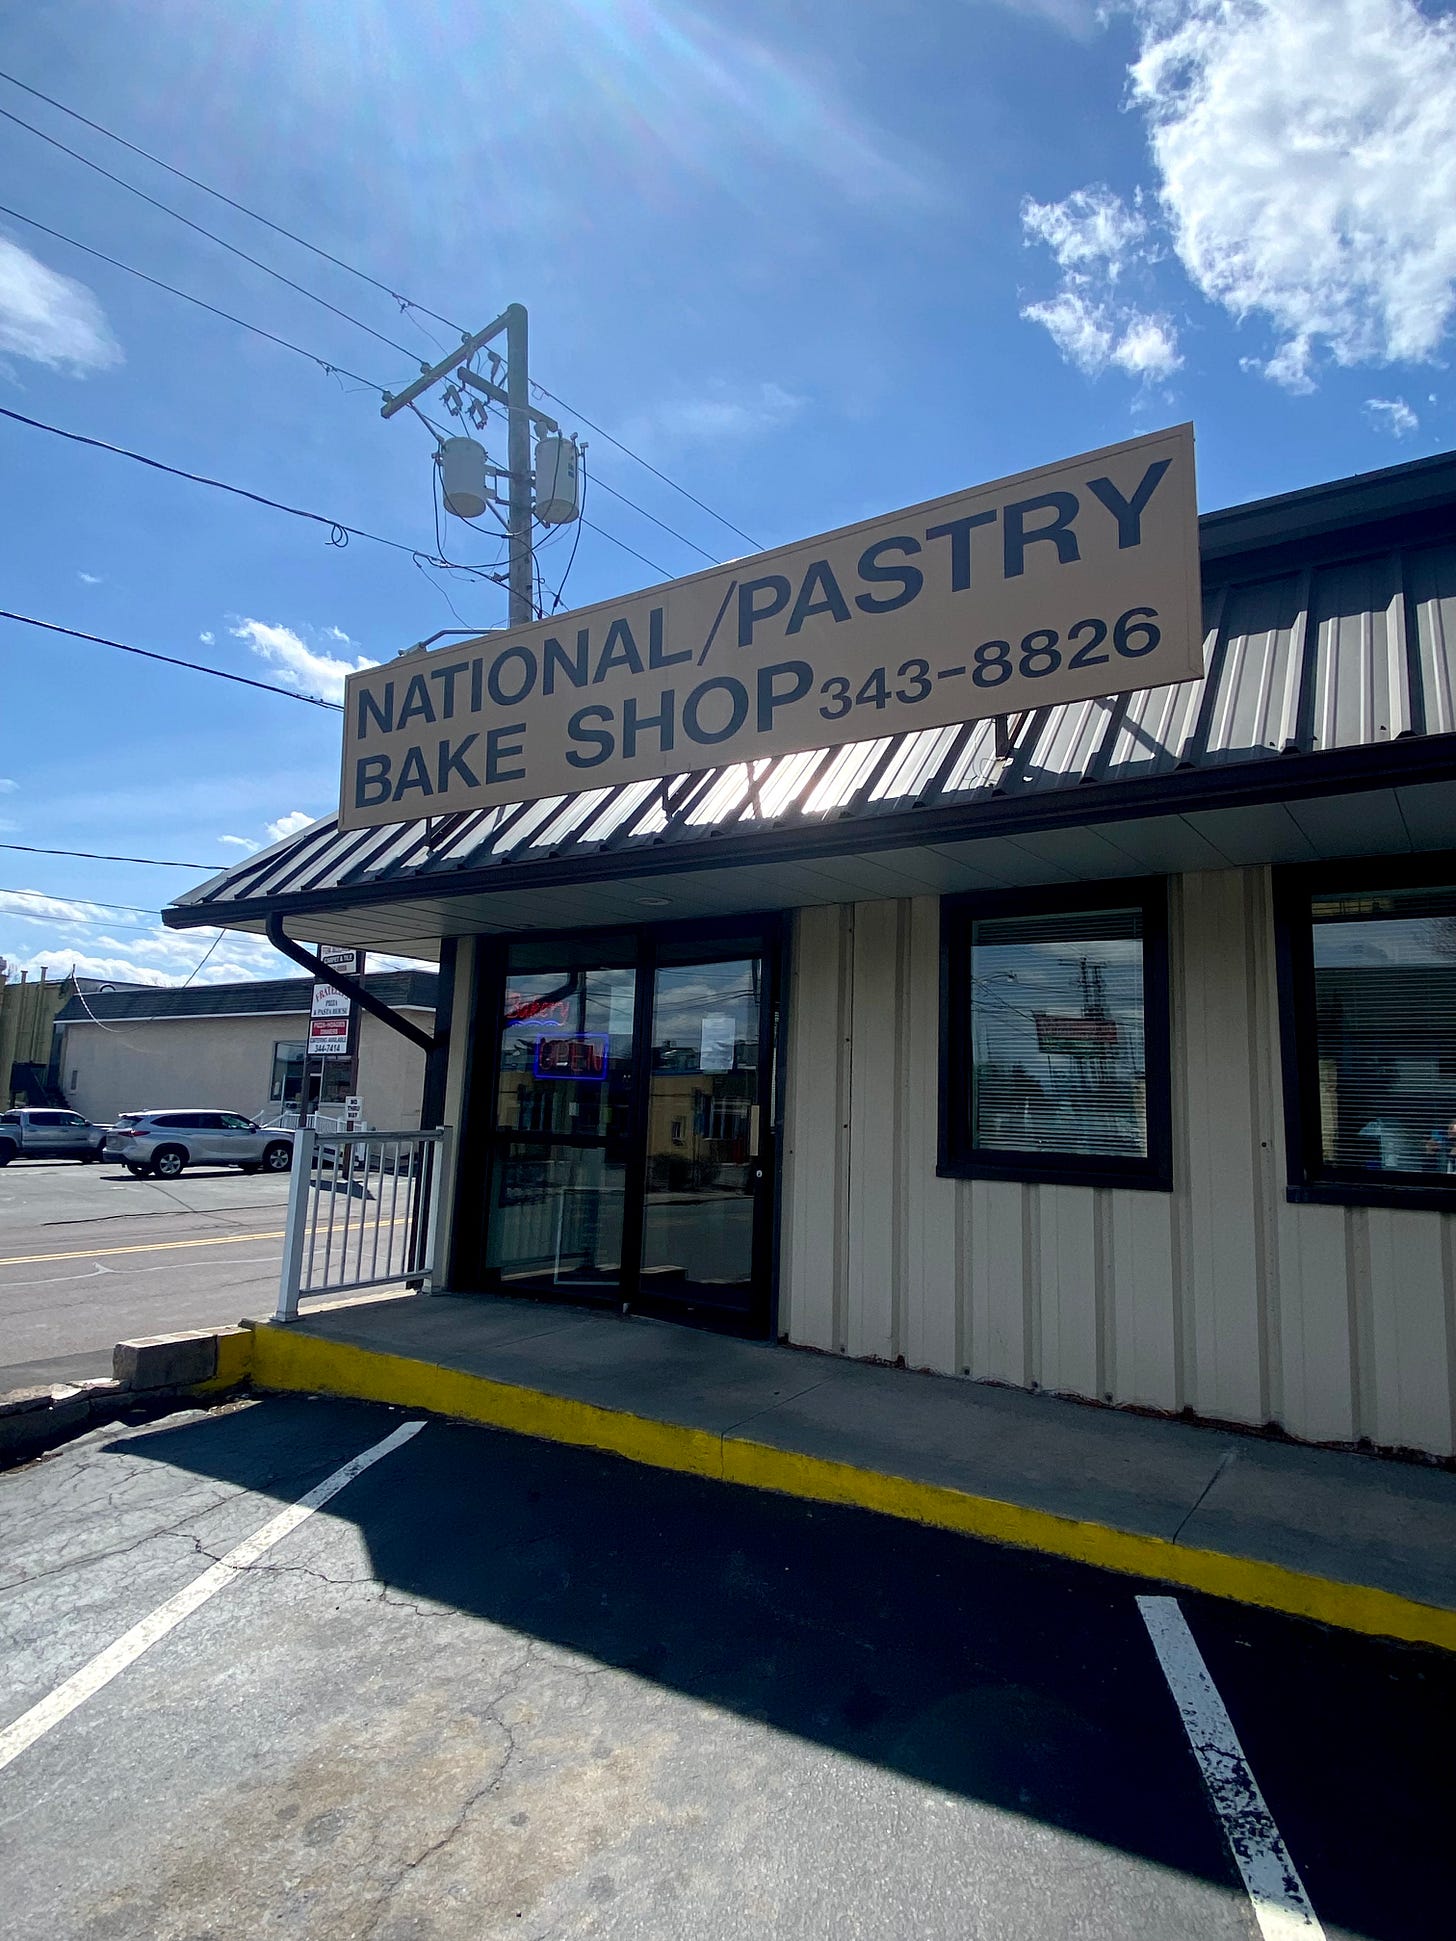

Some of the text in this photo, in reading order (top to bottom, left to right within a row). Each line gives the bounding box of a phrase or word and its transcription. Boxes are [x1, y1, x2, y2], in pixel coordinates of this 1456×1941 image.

[357, 459, 1172, 740] NATIONAL/PASTRY
[355, 606, 1162, 810] BAKE SHOP 343-8826
[315, 1044, 340, 1052] 344-7414
[540, 1040, 602, 1071] OPEN
